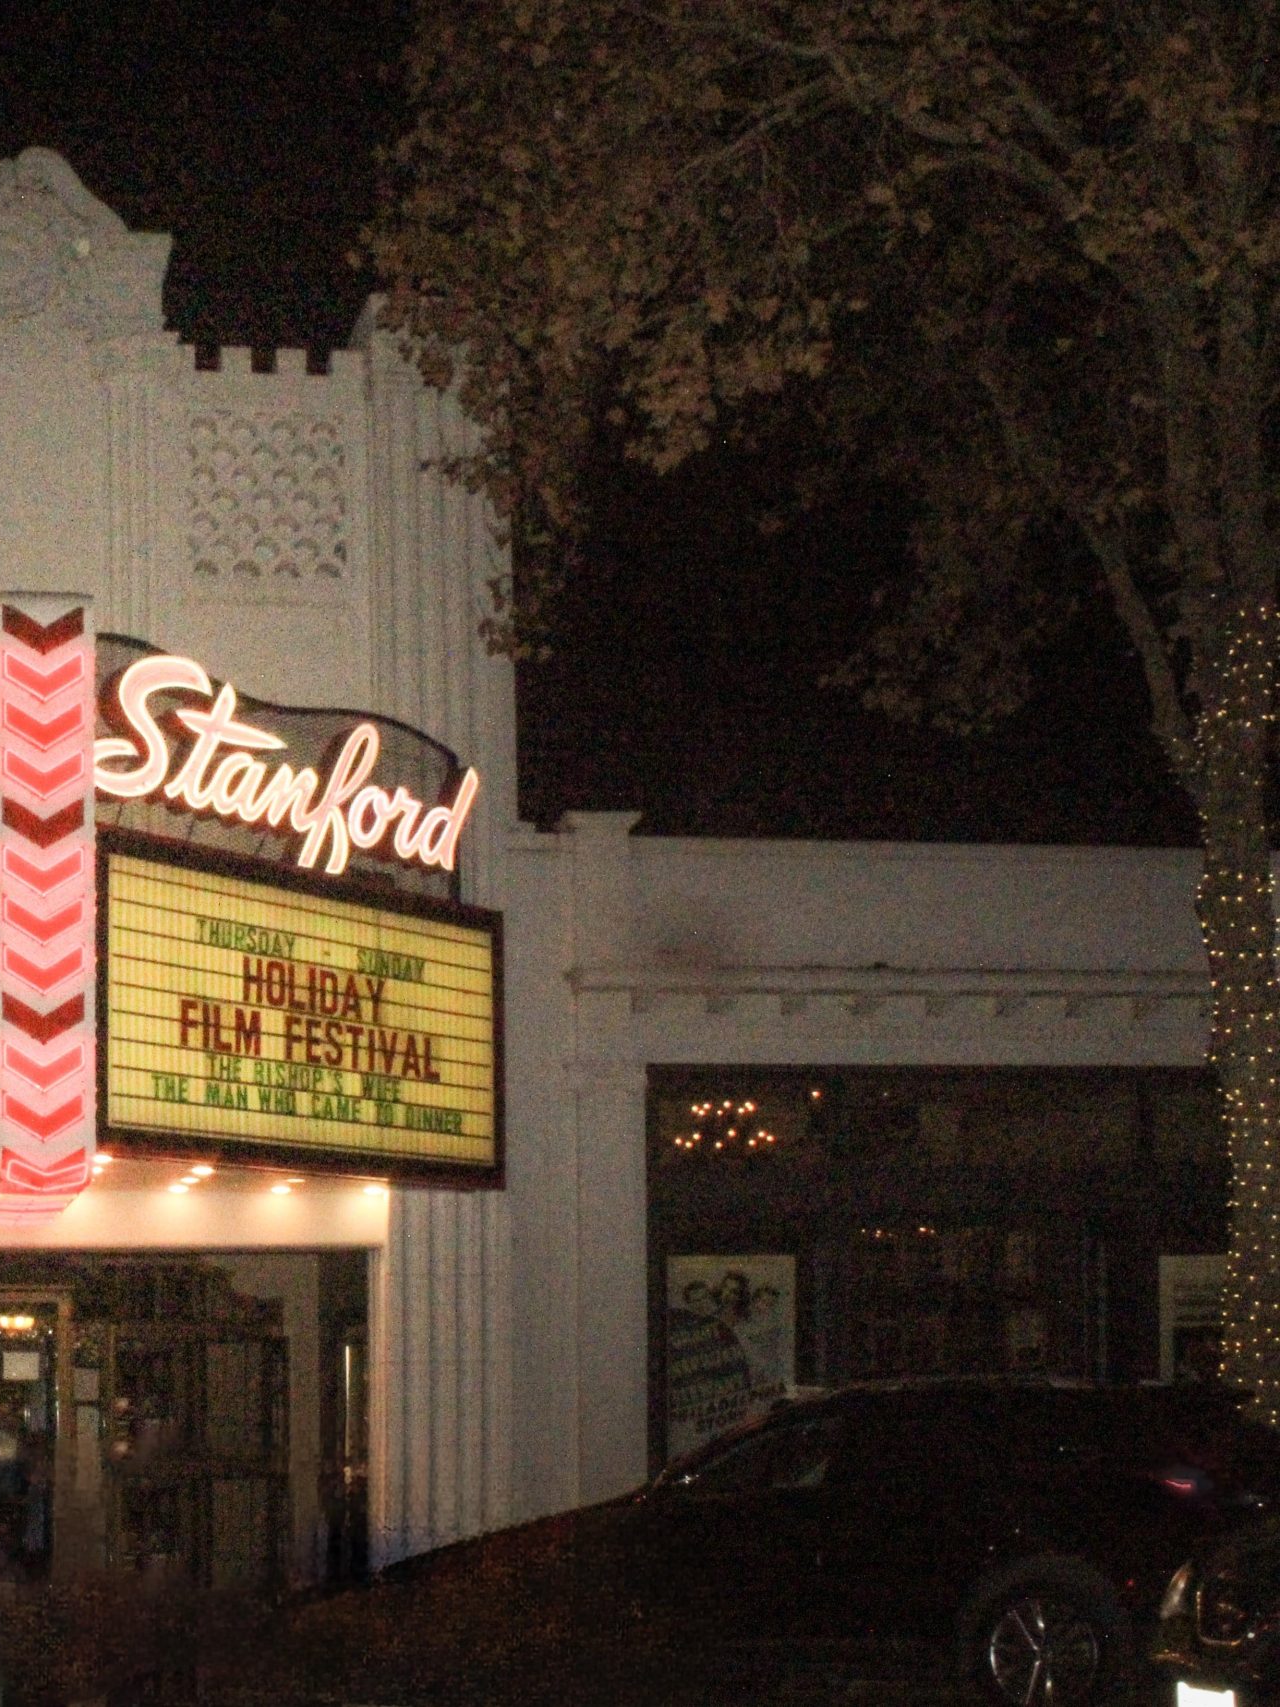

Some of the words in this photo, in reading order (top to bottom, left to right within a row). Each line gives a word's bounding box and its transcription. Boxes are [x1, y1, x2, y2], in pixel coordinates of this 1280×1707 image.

[94, 655, 478, 875] Stanford
[195, 918, 297, 958] THURSDAY
[356, 948, 426, 982] SUNDAY
[242, 955, 386, 1023] HOLIDAY
[179, 999, 262, 1057] FILM
[284, 1014, 441, 1083] FESTIVAL
[151, 1074, 189, 1101] THE
[205, 1082, 249, 1111] MAN
[258, 1087, 297, 1117] WHO
[312, 1095, 361, 1123] CAME
[374, 1100, 394, 1129] TO
[405, 1106, 463, 1137] DINNER
[206, 1052, 242, 1082] THE
[254, 1060, 344, 1096] BISHOP'S
[362, 1073, 402, 1104] WIFE
